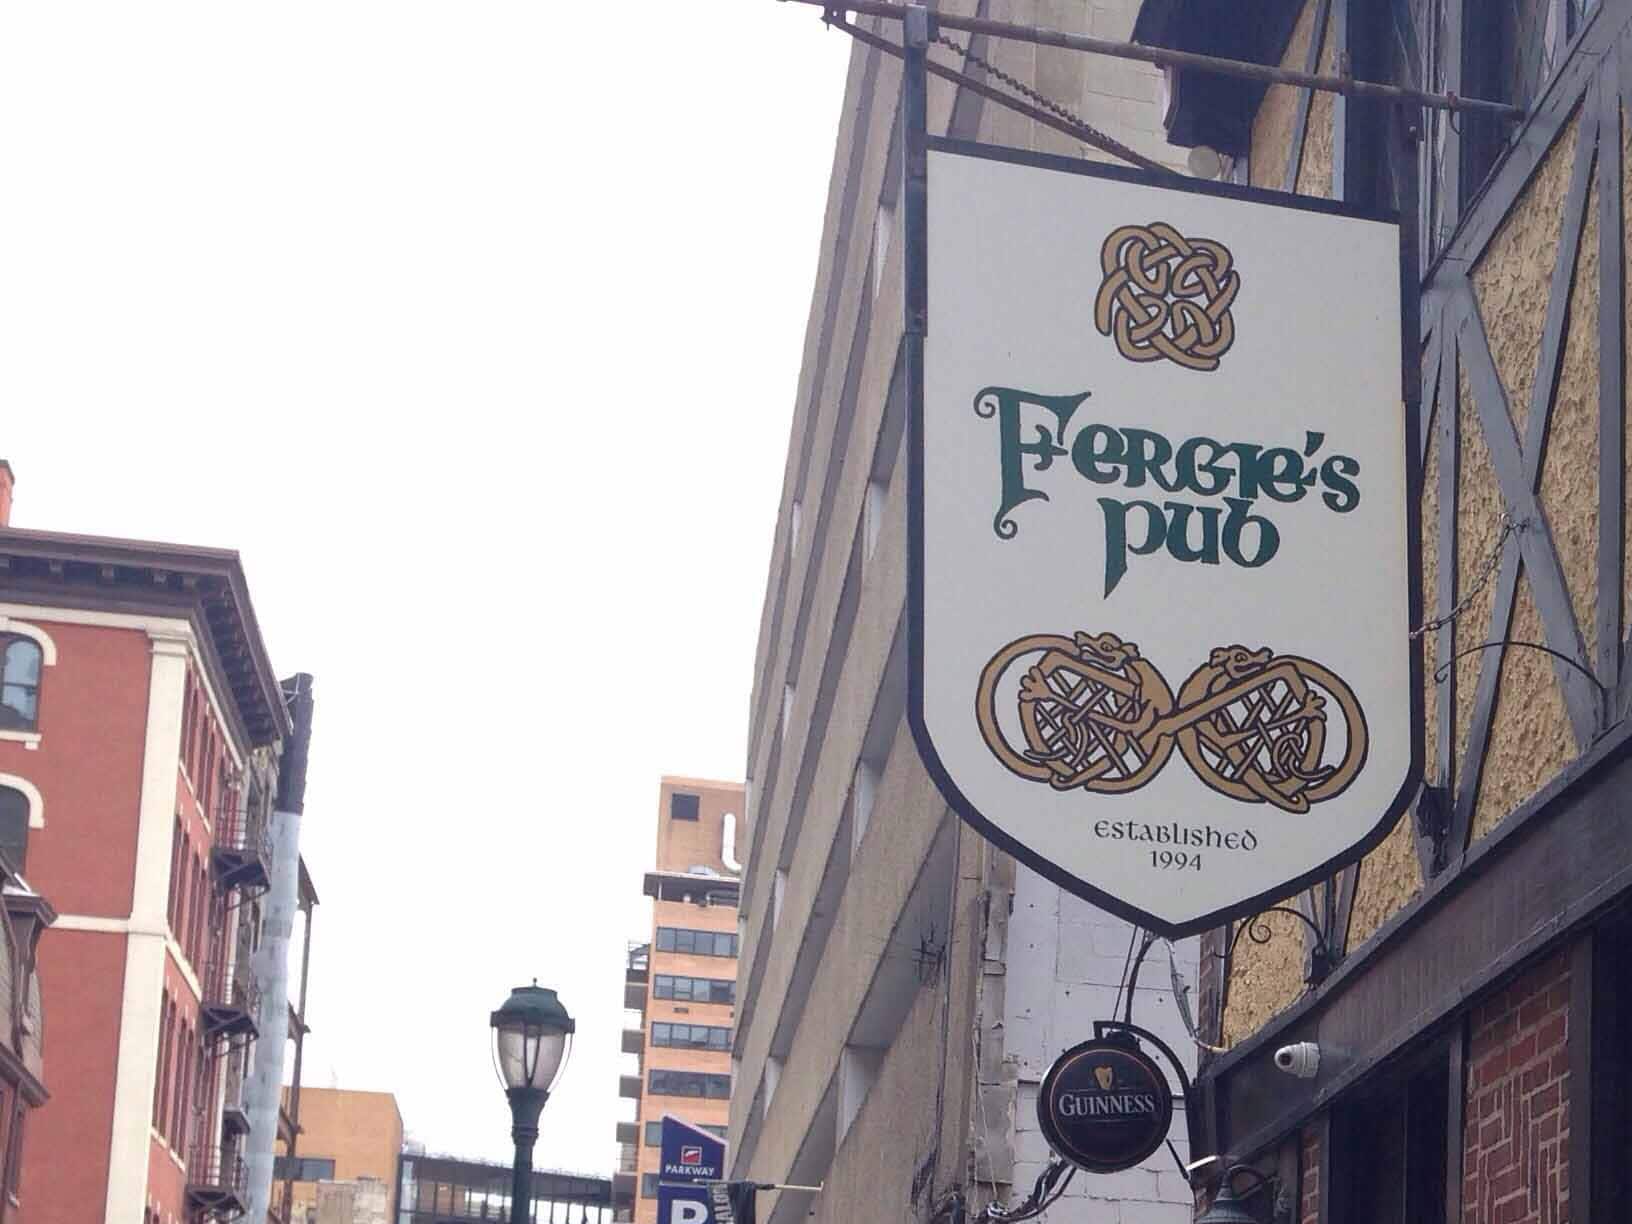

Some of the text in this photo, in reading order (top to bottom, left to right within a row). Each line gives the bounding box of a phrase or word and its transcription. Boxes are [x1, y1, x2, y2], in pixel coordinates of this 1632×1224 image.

[1150, 850, 1202, 871] 1994
[1058, 1093, 1155, 1117] GUINNESS
[665, 1164, 715, 1177] PARKWAY
